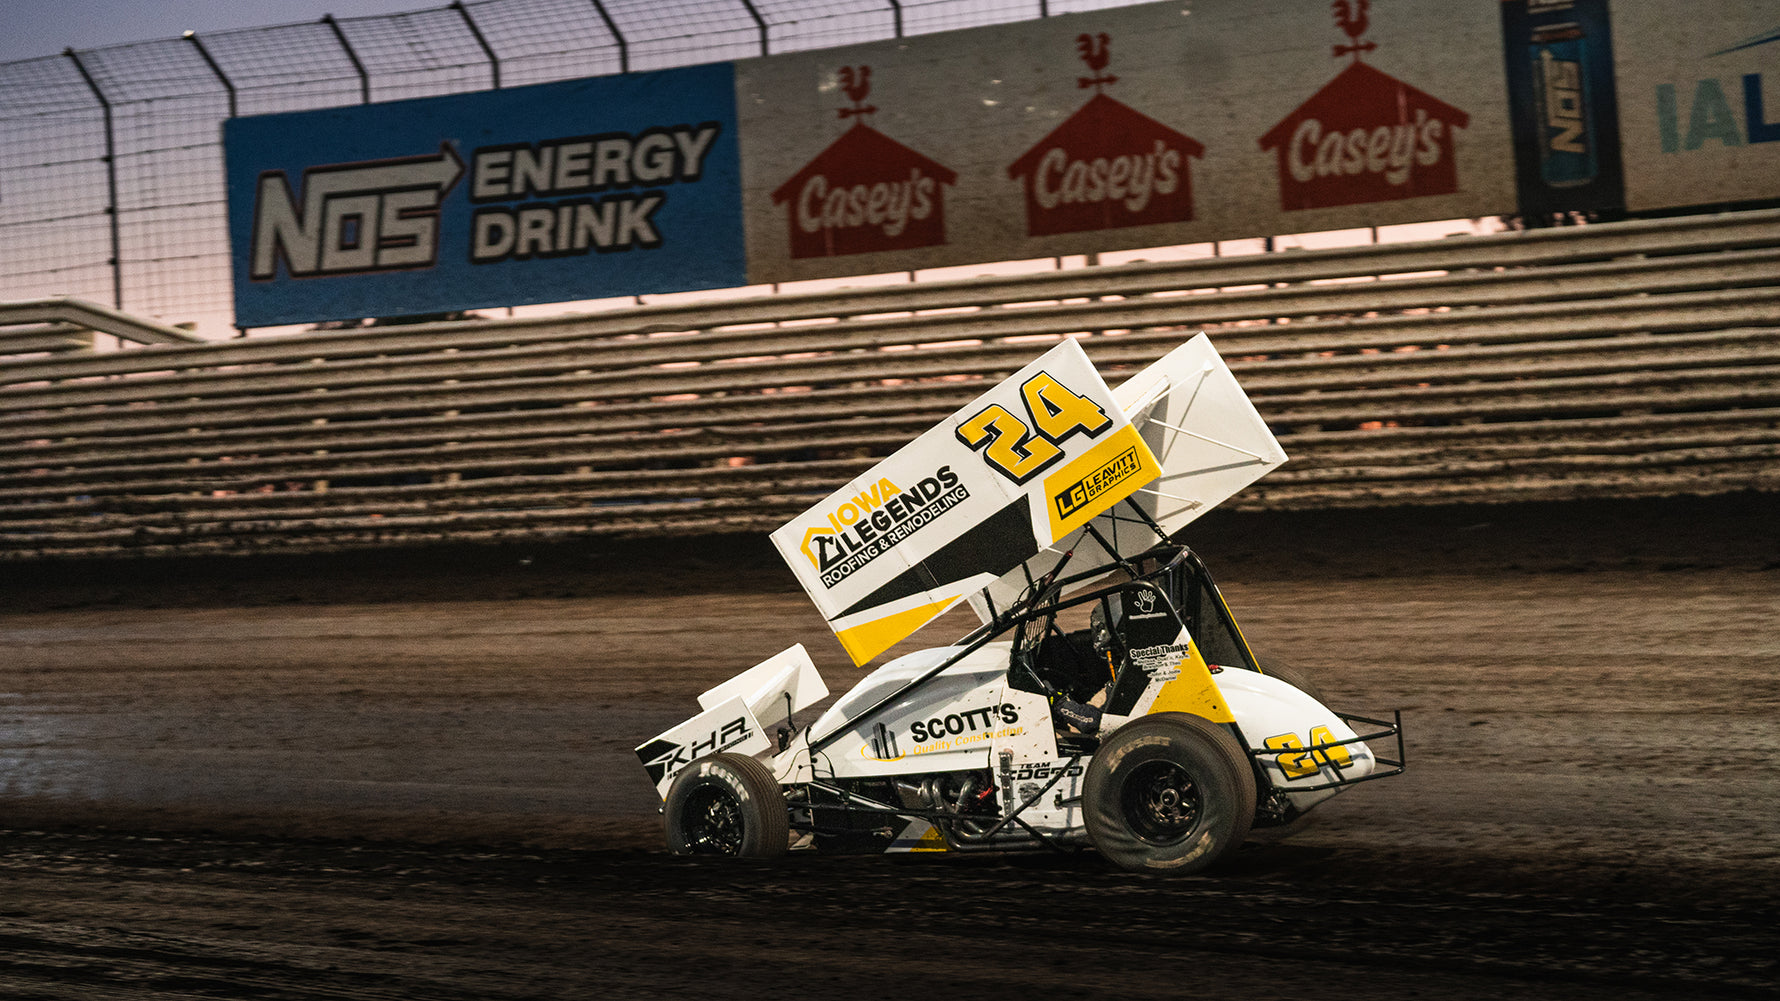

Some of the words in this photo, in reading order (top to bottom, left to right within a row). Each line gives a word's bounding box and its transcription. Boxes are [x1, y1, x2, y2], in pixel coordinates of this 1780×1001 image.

[471, 123, 720, 202] ENERGY
[1034, 139, 1181, 213] Casey's
[1287, 109, 1444, 185] Casey's
[251, 145, 465, 280] NOS
[470, 192, 663, 263] DRINK
[797, 167, 936, 237] Casey's
[955, 370, 1113, 486] 24
[827, 477, 902, 533] IOWA
[1057, 484, 1087, 517] LG
[1085, 451, 1134, 490] LEAVITT
[1088, 462, 1137, 497] GRAPHICS
[822, 545, 879, 587] ROOFING
[879, 538, 890, 550] &
[887, 487, 967, 544] REMODELING
[840, 465, 959, 552] LEGENDS
[1130, 646, 1161, 659] Special
[1160, 643, 1189, 655] Thanks
[910, 703, 1019, 743] SCOTT'S
[913, 739, 952, 755] Quality
[1263, 725, 1354, 782] 24
